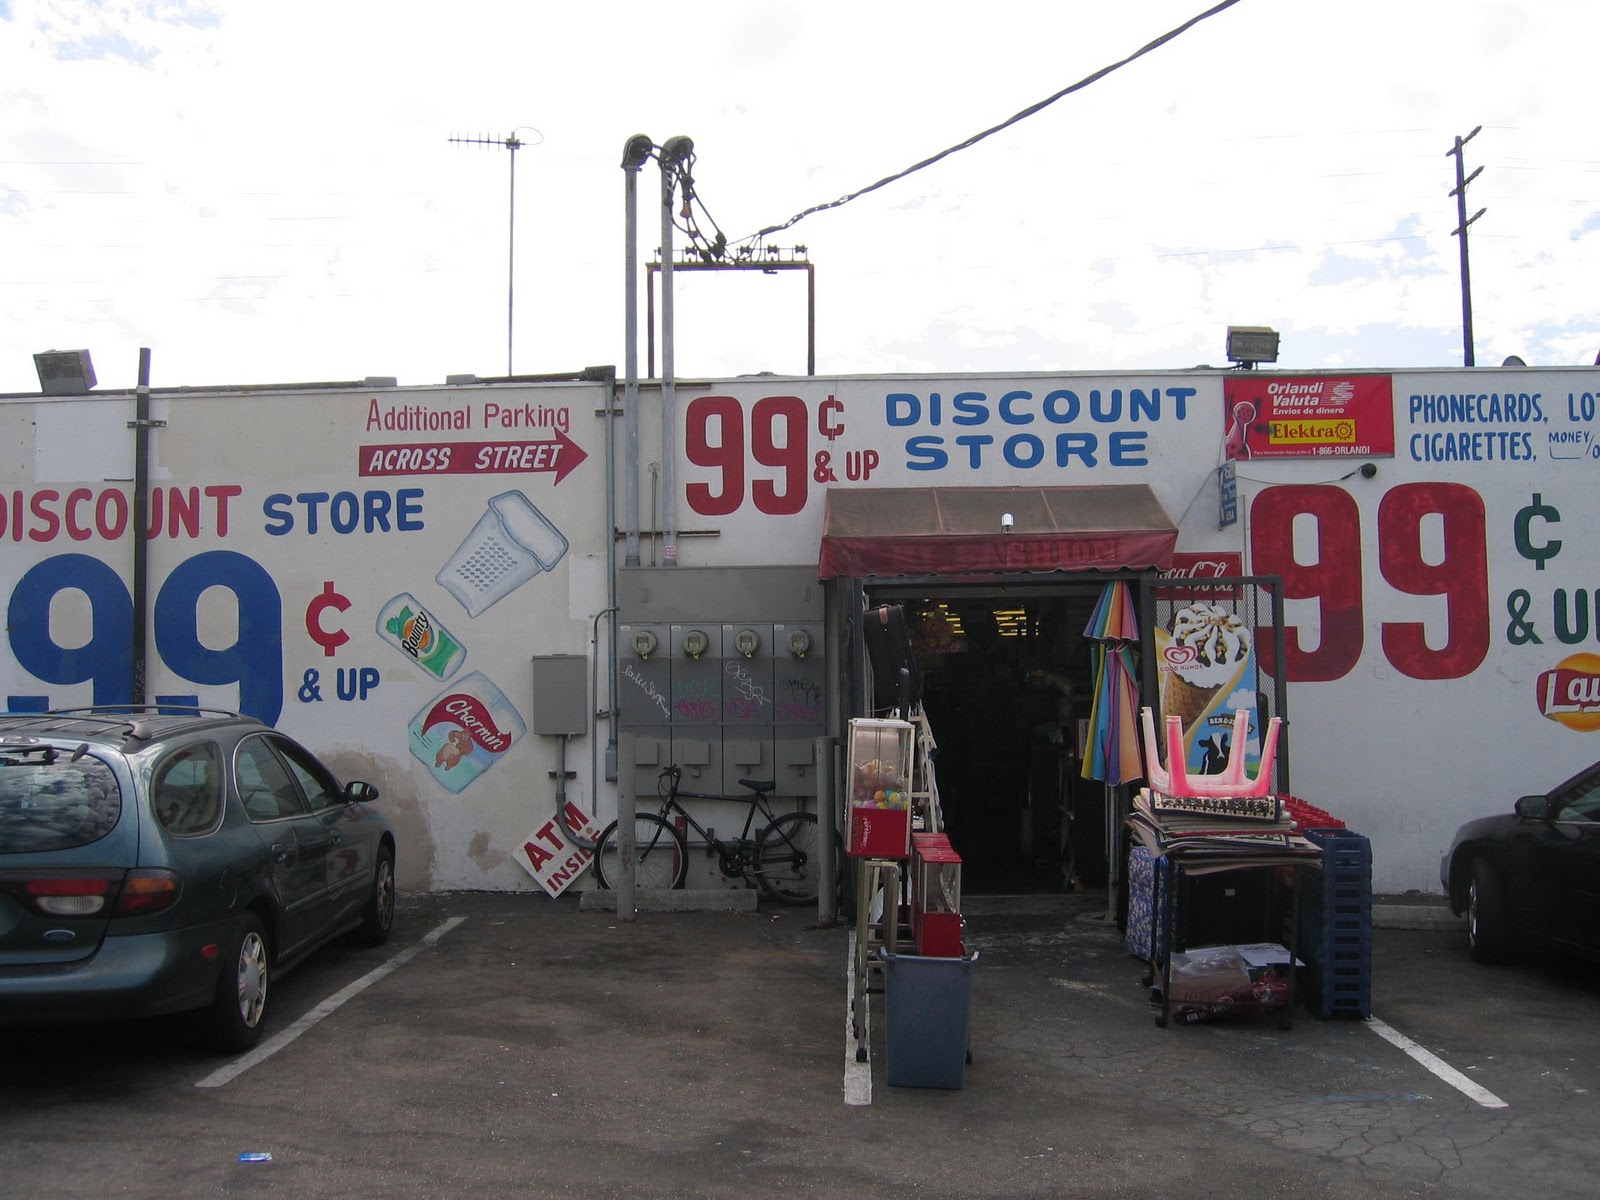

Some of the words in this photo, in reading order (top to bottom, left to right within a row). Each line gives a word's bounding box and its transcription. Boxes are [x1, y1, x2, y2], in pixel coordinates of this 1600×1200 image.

[1267, 382, 1324, 394] Orlandi
[1272, 394, 1320, 406] Valuta
[366, 398, 471, 431] Additional
[484, 403, 570, 433] Parking
[885, 387, 1197, 427] DISCOUNT
[1303, 407, 1314, 415] de
[1316, 407, 1345, 415] dinero
[1409, 393, 1548, 424] PHONECARDS,
[1568, 392, 1600, 422] LO
[1272, 423, 1335, 439] Elektra
[1409, 431, 1537, 462] CIGARETTES,
[368, 447, 452, 472] ACROSS
[475, 444, 563, 470] STREET
[685, 395, 808, 515] 99
[813, 450, 837, 484] &
[847, 449, 879, 481] UP
[905, 431, 1149, 471] STORE
[1312, 446, 1371, 456] 1-866-ORLANDI
[0, 484, 242, 543] ISCOUNT
[263, 488, 424, 536] STORE
[1250, 481, 1490, 682] 99
[1506, 588, 1544, 646] &
[1553, 588, 1600, 645] U
[7, 550, 283, 728] 99
[402, 611, 429, 659] Bounty
[298, 668, 323, 702] &
[336, 668, 380, 700] UP
[445, 700, 504, 750] Charmin
[524, 801, 589, 872] ATM
